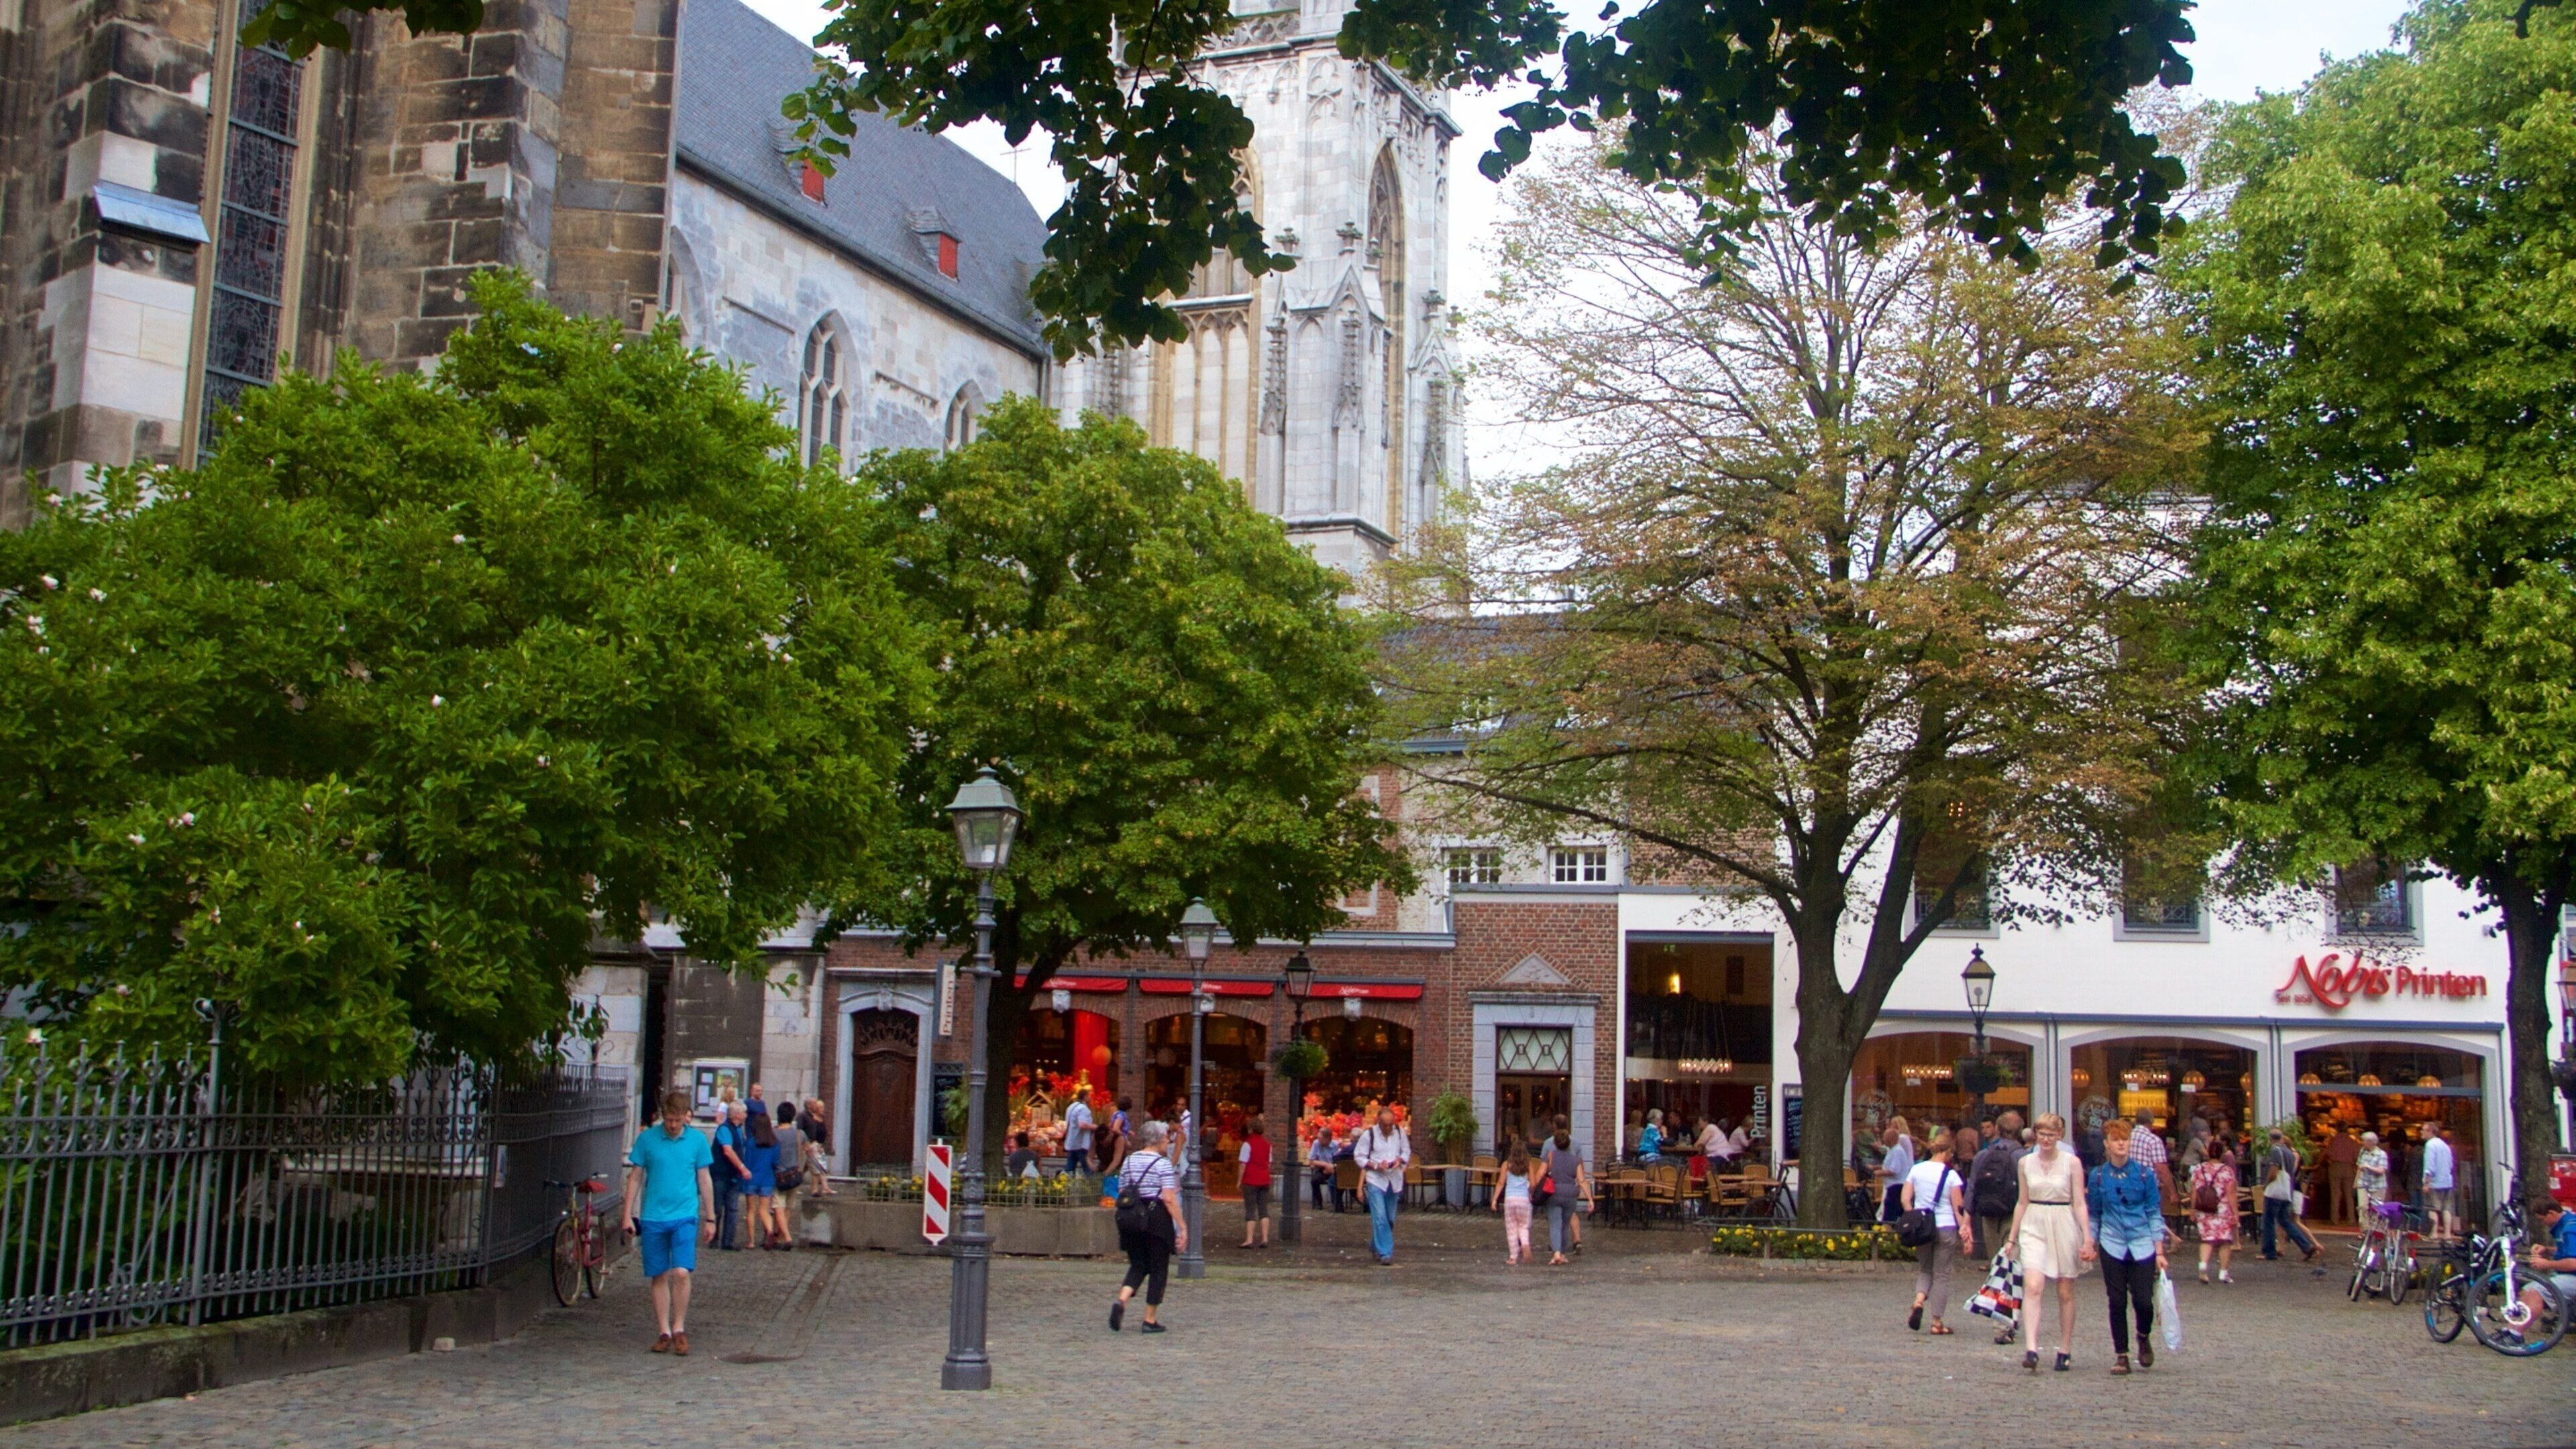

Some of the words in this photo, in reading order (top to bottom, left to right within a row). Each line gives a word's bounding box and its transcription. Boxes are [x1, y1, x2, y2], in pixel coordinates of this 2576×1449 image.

[2274, 949, 2392, 1007] Nobis
[2396, 965, 2487, 996] Printen
[943, 980, 953, 1032] Printen
[1750, 1085, 1766, 1138] Printen
